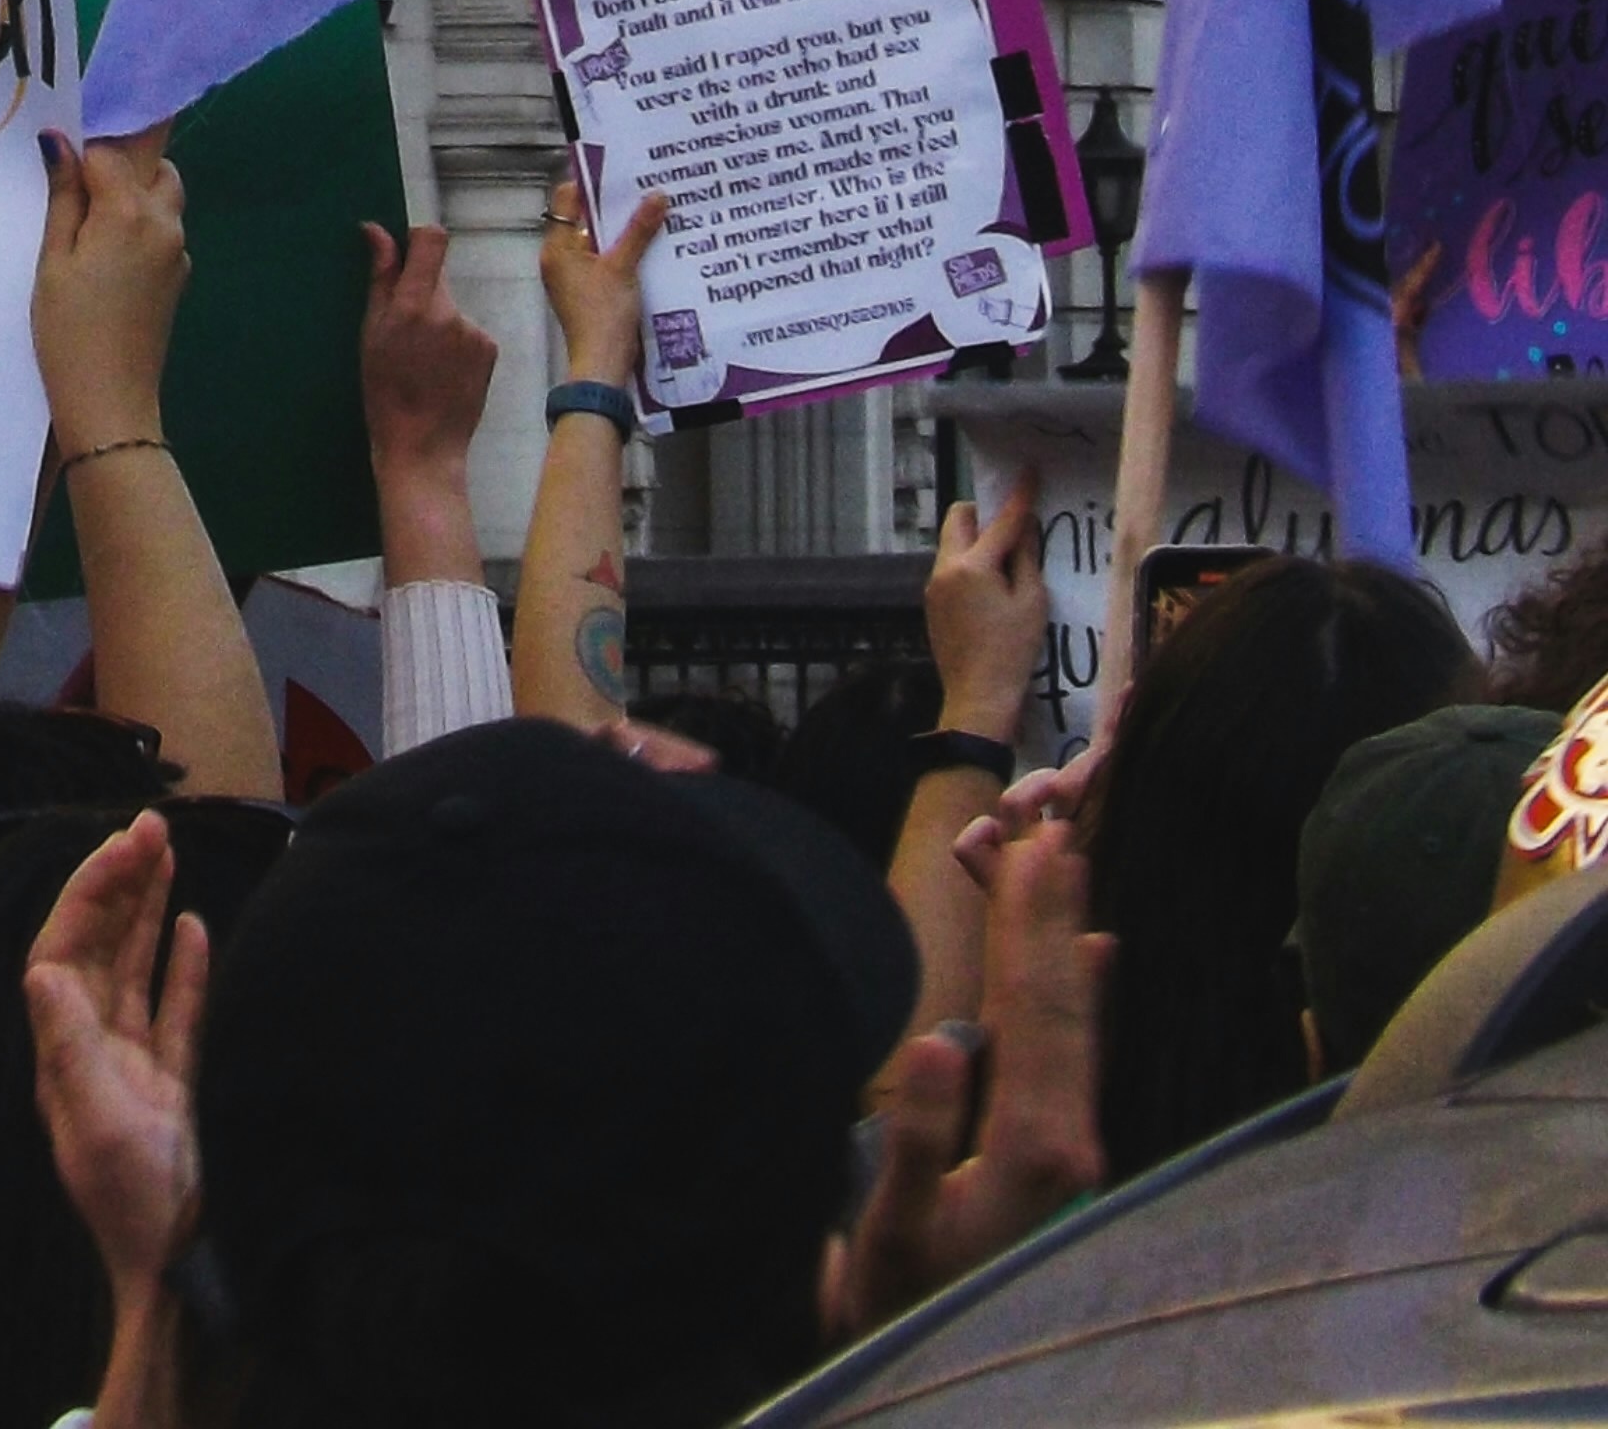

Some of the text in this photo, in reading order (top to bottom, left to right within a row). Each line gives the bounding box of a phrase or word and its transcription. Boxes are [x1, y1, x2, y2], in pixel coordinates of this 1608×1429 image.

[614, 8, 932, 90] You said I raped you, but you
[616, 12, 668, 40] fault
[674, 1, 715, 27] and
[635, 35, 921, 112] were the one who had sex
[690, 68, 877, 126] with a drunk and
[635, 158, 717, 190] woman
[723, 148, 770, 171] was
[775, 140, 814, 161] me.
[820, 124, 863, 150] And
[914, 106, 955, 139] you
[648, 84, 931, 162] unconscious woman. That
[663, 159, 945, 235] like a monster. Who is the
[665, 129, 959, 209] amed me and made me feel
[674, 182, 949, 259] real monster here if I still
[700, 214, 934, 279] can't remember what
[707, 236, 936, 304] happened that night?
